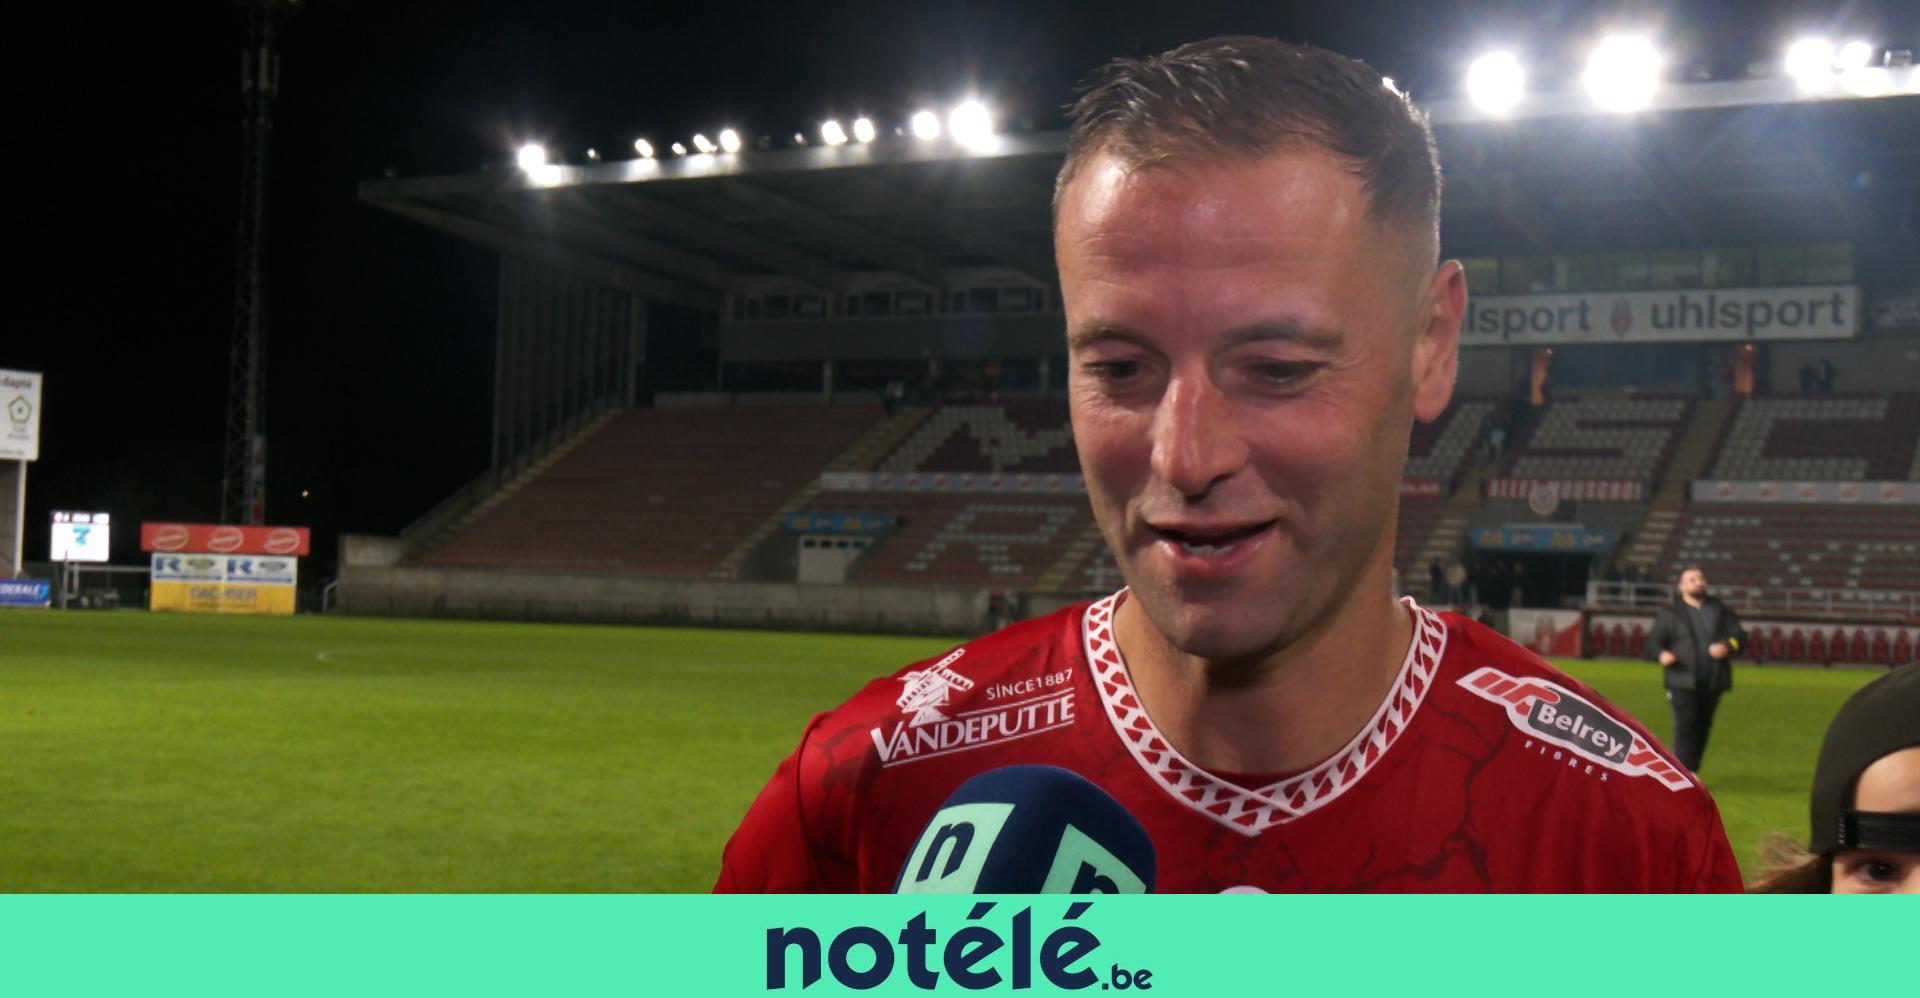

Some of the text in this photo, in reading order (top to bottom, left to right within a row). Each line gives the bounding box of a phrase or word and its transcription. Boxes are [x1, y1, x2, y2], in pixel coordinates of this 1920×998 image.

[1462, 299, 1591, 339] lsport
[1650, 292, 1846, 336] uhlsport
[870, 693, 1075, 762] VANDEPUTTE
[1536, 703, 1625, 756] Belrey
[915, 821, 976, 883] n
